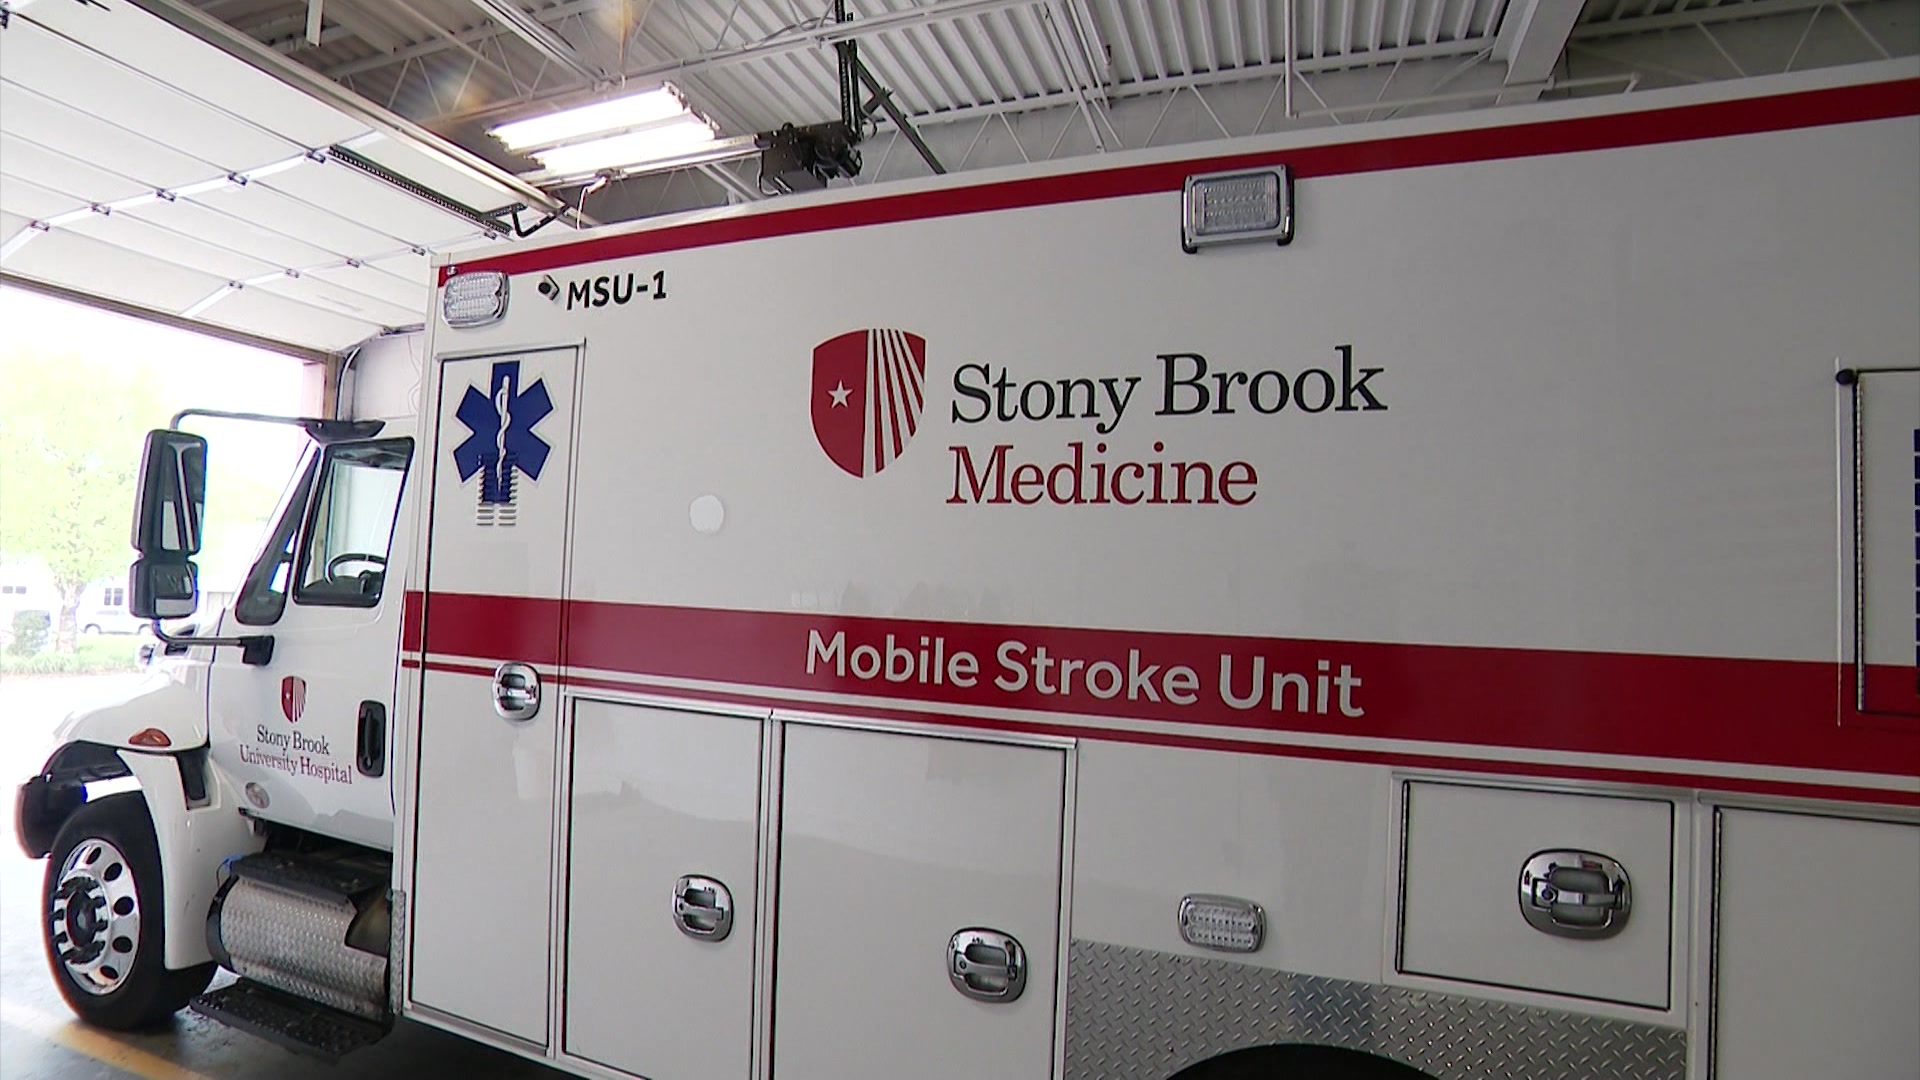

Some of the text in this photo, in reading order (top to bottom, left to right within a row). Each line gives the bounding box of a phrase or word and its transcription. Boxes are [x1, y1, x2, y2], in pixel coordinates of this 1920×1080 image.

[567, 270, 667, 310] MSU-1
[952, 345, 1388, 434] Stony Brook
[946, 441, 1258, 505] Medicine
[805, 630, 1364, 718] Mobile Stroke Unit
[240, 744, 353, 785] University Hospital
[257, 724, 330, 756] Stony Brook
